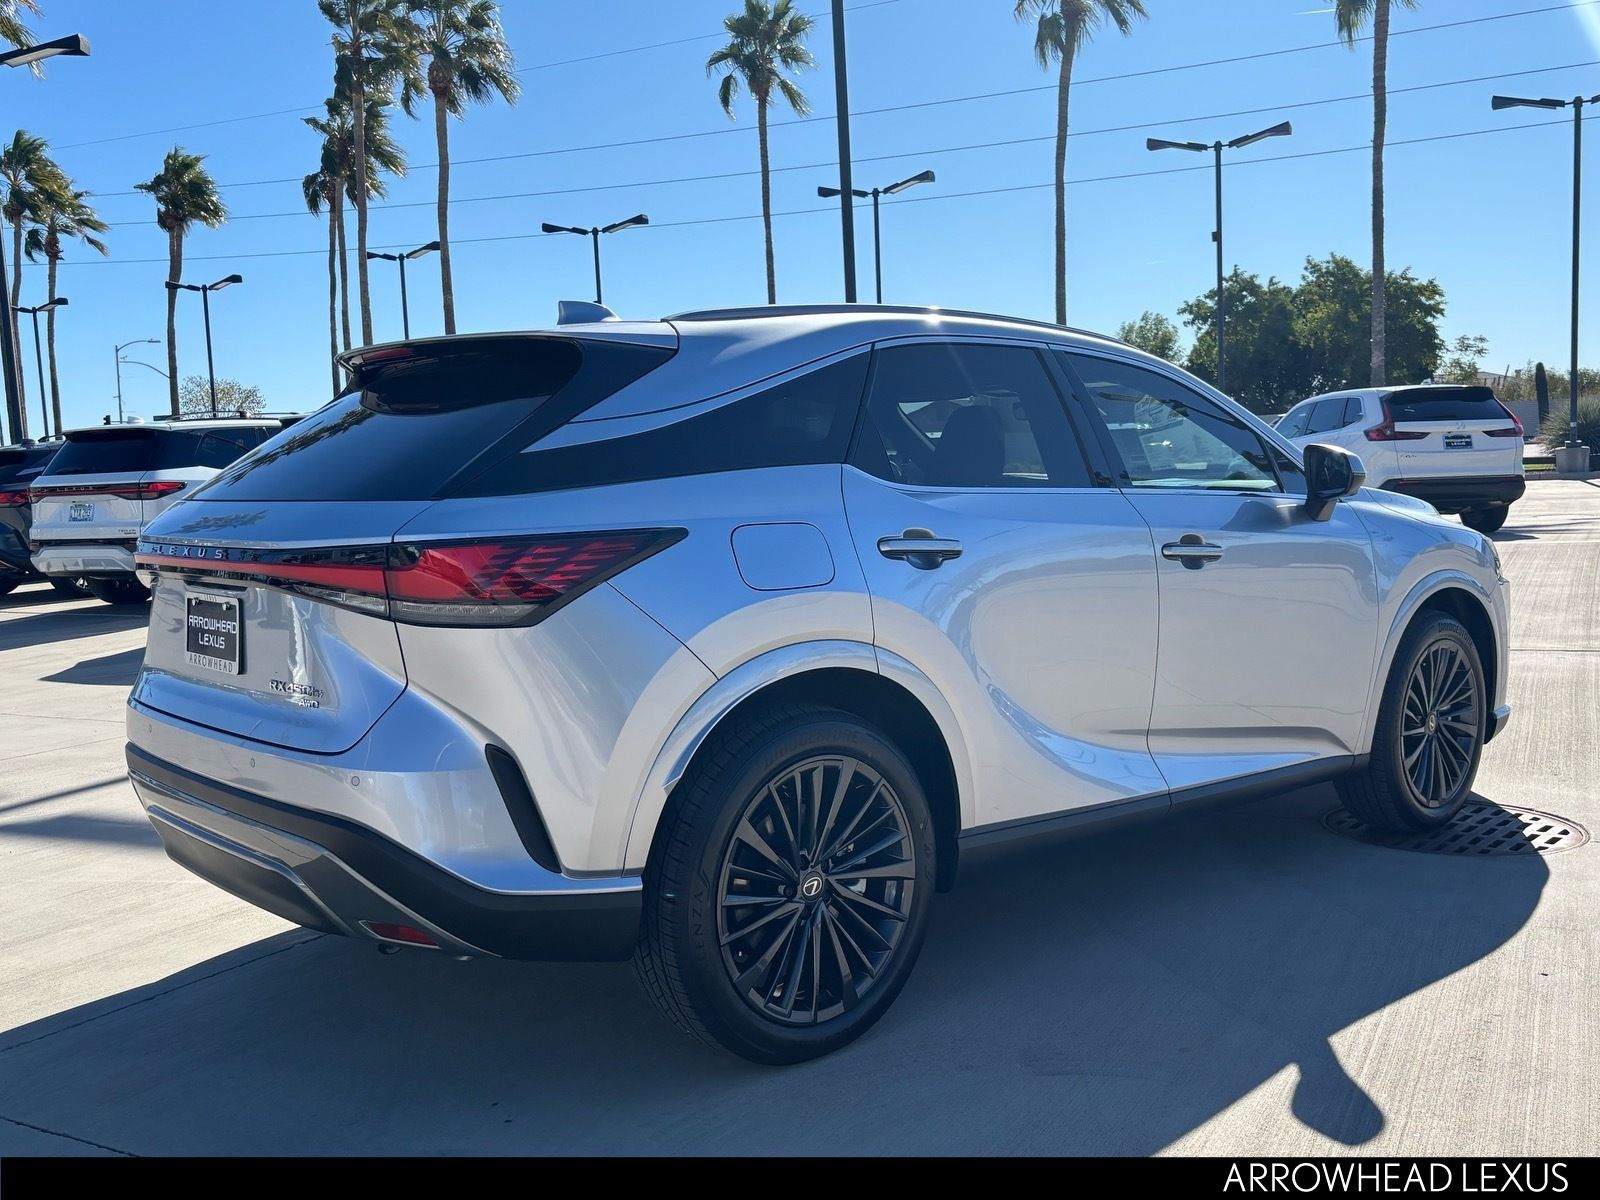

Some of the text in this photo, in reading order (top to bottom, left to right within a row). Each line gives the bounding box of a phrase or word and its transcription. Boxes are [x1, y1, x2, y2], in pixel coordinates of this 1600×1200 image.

[157, 545, 222, 558] LEXUS
[188, 615, 237, 634] ARROWHEAD
[198, 632, 226, 649] LEXUS
[188, 653, 233, 673] ARROWHEAD
